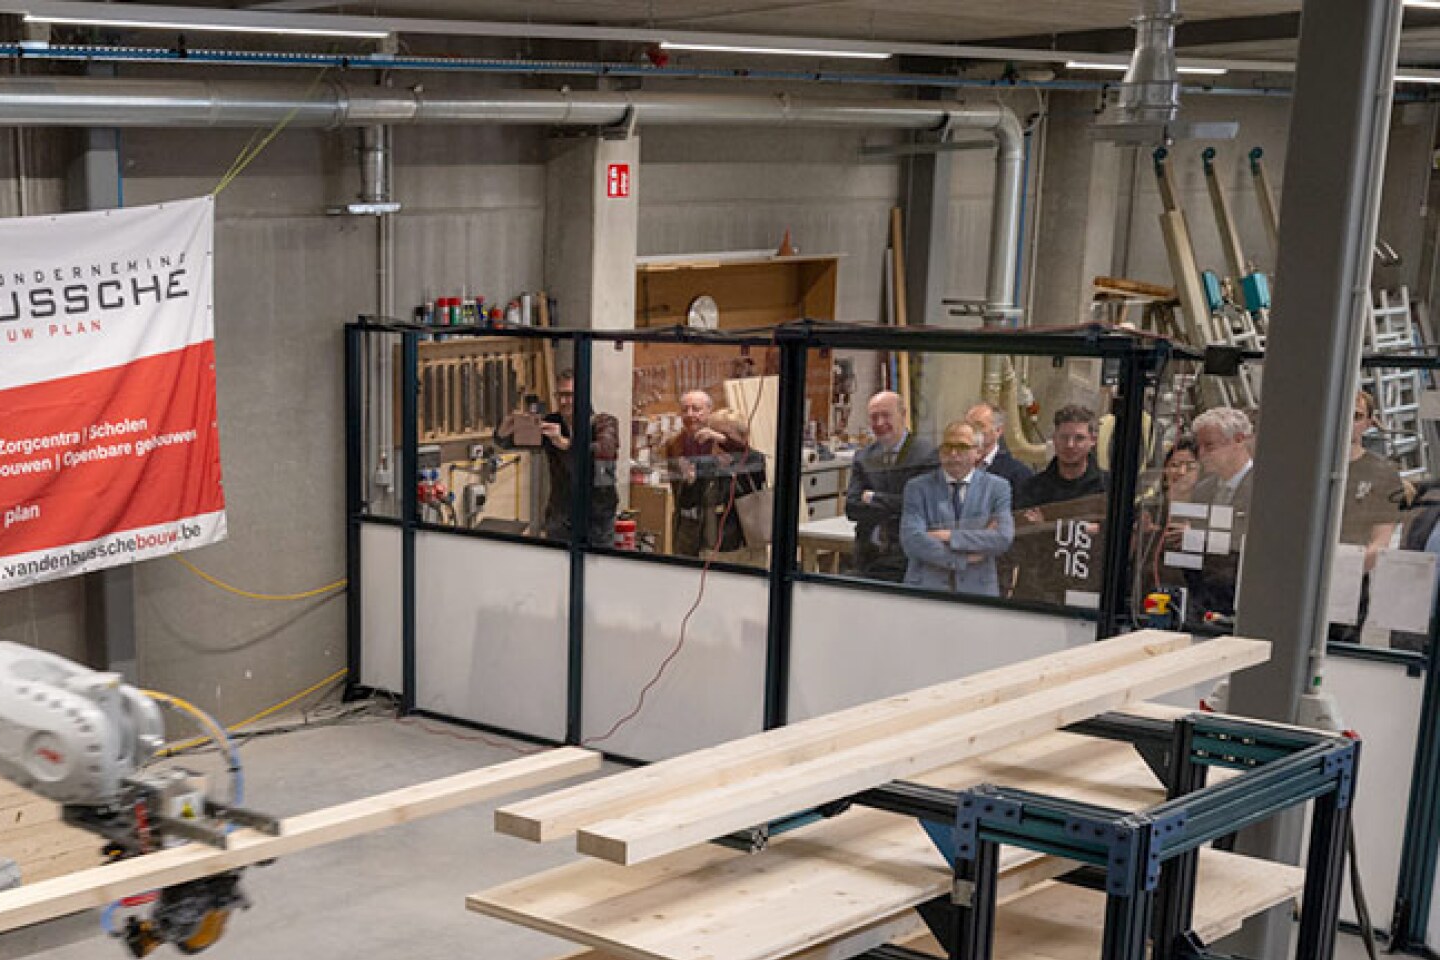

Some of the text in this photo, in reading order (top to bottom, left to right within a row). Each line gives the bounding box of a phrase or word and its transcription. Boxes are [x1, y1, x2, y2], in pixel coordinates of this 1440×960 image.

[7, 328, 33, 342] UW
[49, 320, 101, 336] PLAN
[88, 417, 148, 440] Scholen
[63, 443, 132, 466] Openbare
[4, 504, 40, 528] plan
